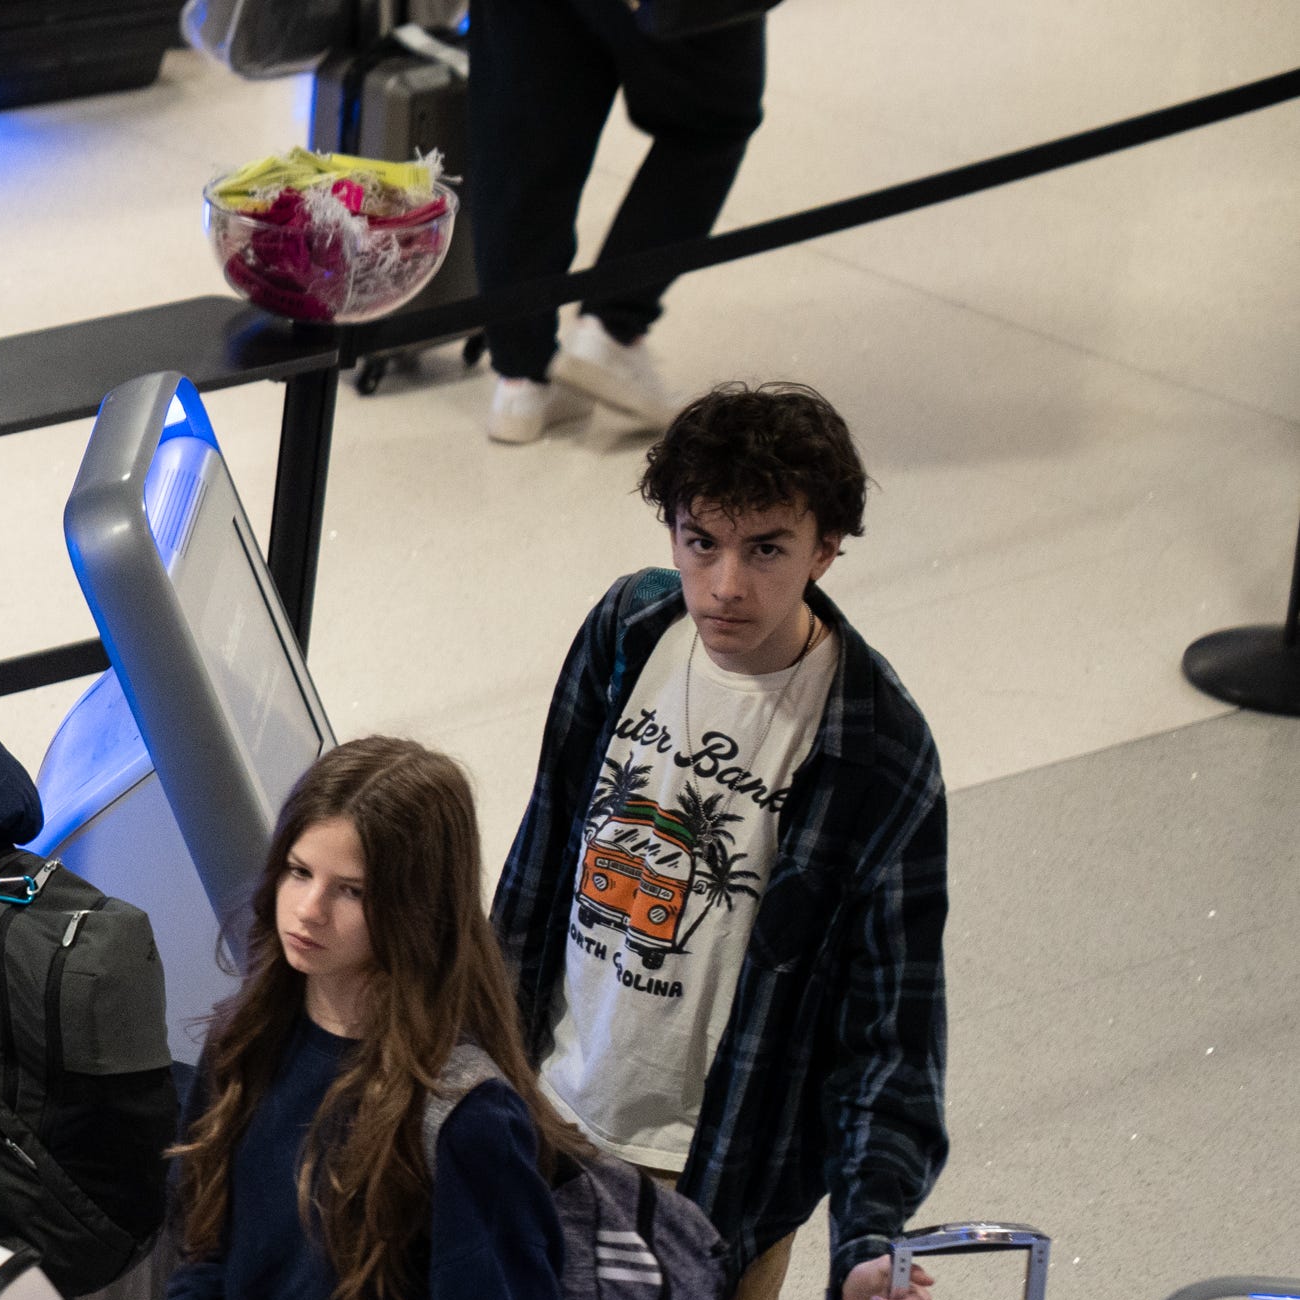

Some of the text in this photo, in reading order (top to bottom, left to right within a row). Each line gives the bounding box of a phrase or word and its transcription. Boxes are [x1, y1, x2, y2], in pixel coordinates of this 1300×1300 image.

[614, 707, 792, 813] uter Bank
[567, 923, 684, 998] ORTH COLINA
